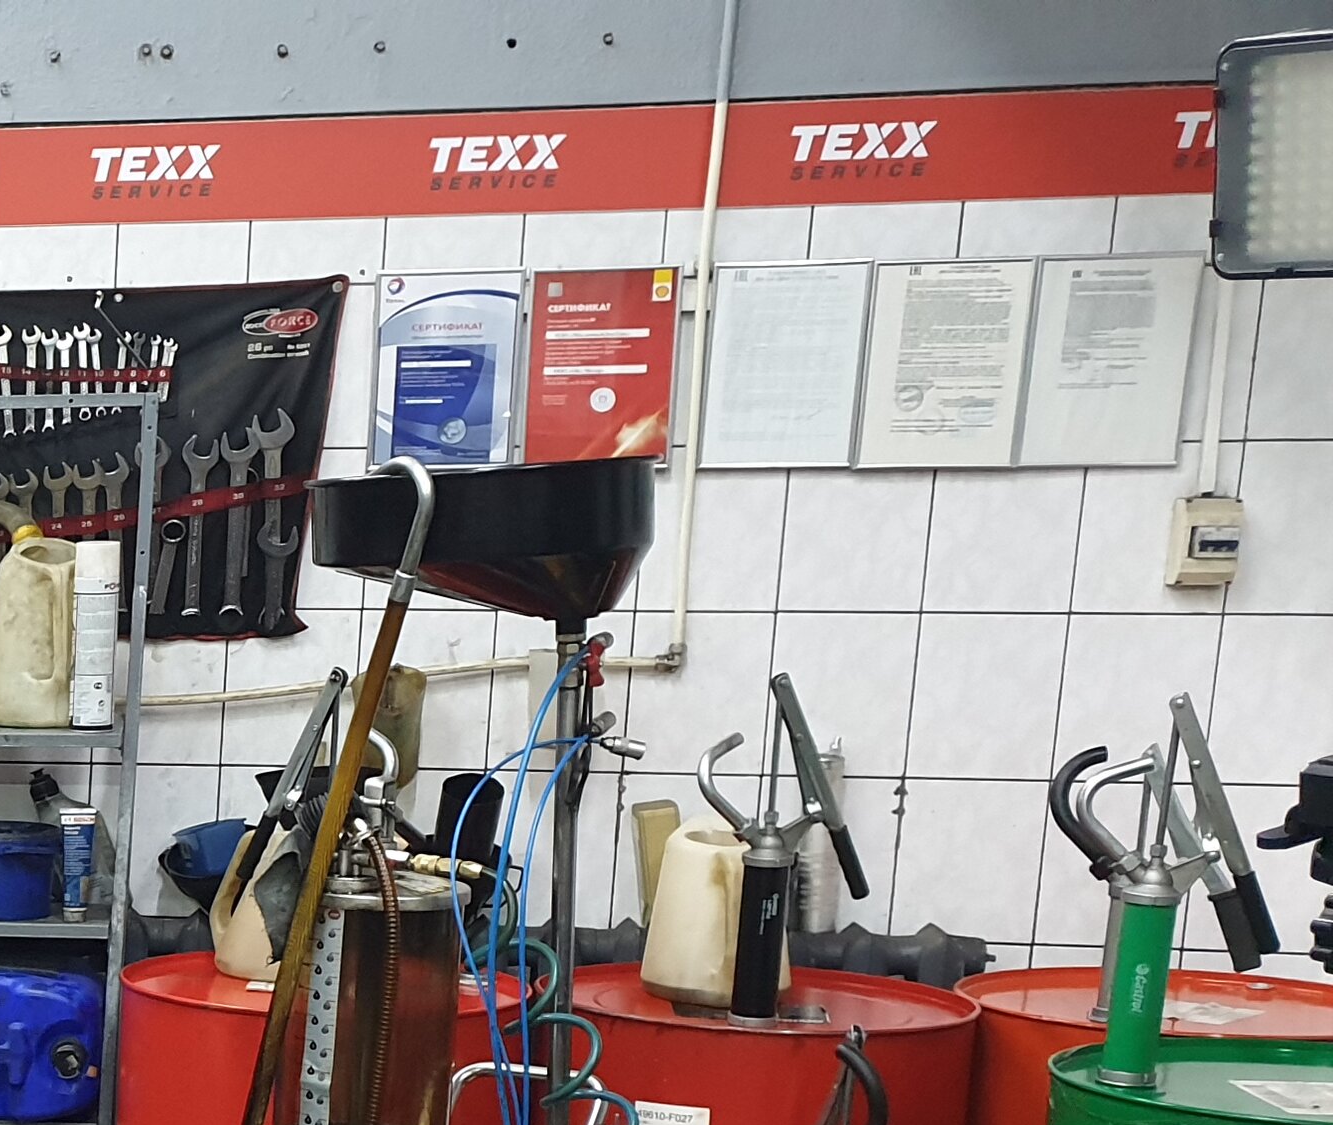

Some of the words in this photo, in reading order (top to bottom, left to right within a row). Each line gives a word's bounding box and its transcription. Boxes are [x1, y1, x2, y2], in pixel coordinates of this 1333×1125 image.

[791, 121, 937, 161] TEXX
[91, 145, 220, 182] TEXX
[430, 134, 567, 173] TEXX
[790, 160, 929, 182] SERVICE
[92, 181, 212, 200] SERVICE
[430, 172, 558, 193] SERVICE
[547, 303, 612, 314] СЕРТИФИКАТ
[269, 314, 312, 328] FORCE
[411, 322, 483, 332] СЕРТИФИКАТ
[113, 369, 120, 377] 9
[159, 369, 166, 378] 6
[51, 522, 62, 531] 24
[1131, 975, 1147, 1013] Castrol
